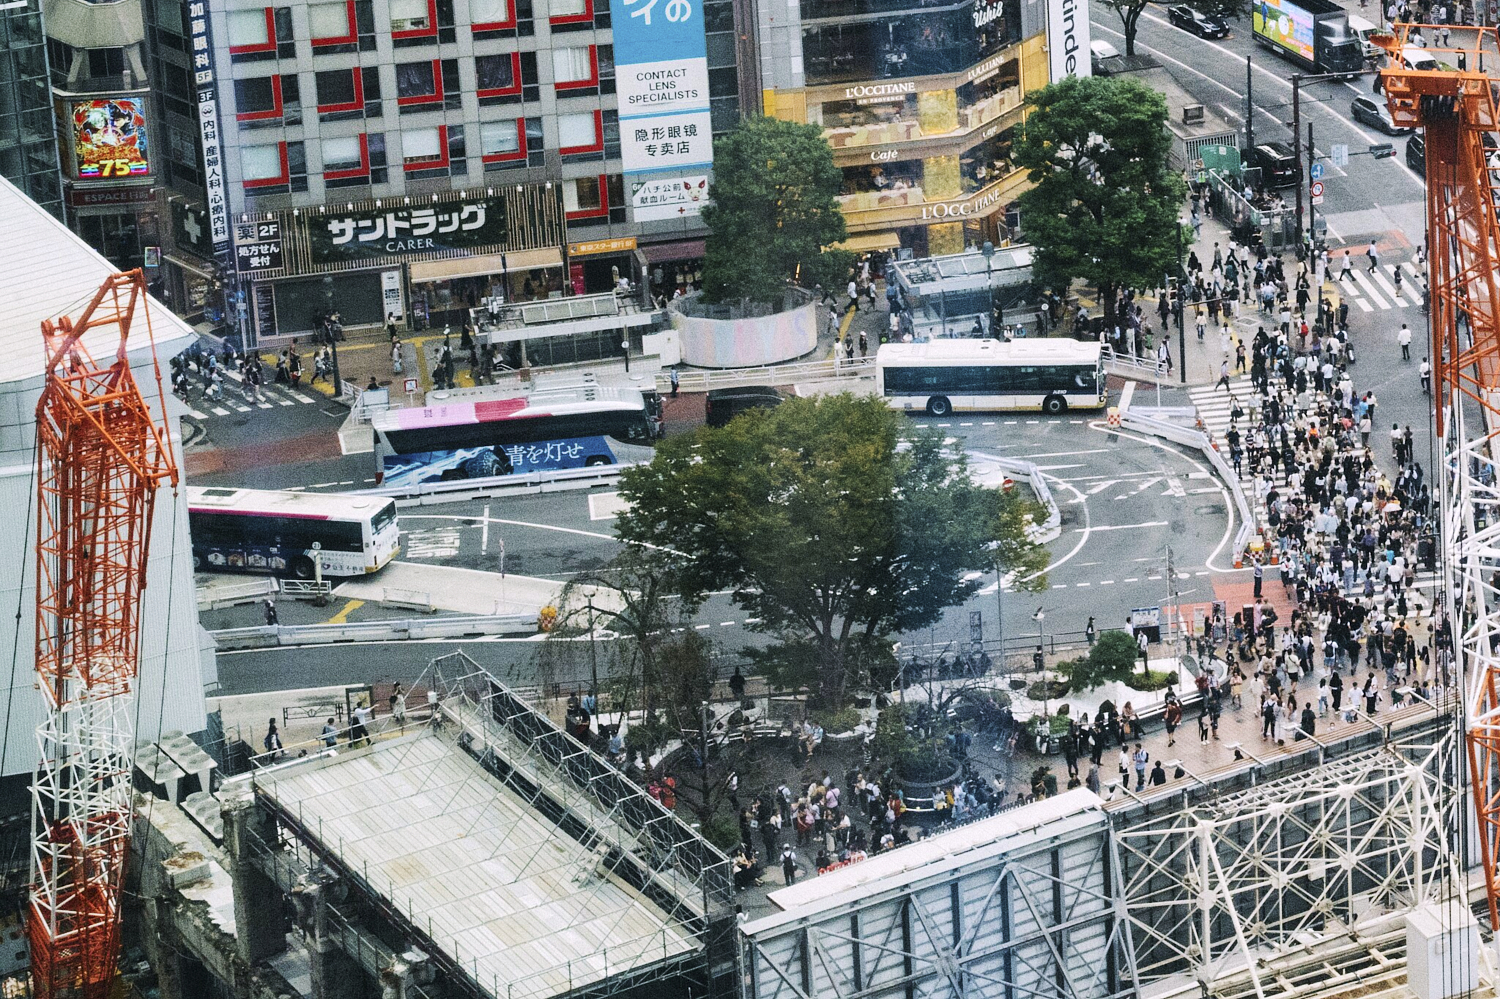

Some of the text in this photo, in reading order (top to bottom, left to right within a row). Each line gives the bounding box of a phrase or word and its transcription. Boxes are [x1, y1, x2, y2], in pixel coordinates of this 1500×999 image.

[190, 3, 210, 68] 加藤眼科
[636, 68, 687, 81] CONTACT
[649, 80, 676, 91] LENS
[199, 92, 213, 102] 3F
[628, 89, 698, 104] SPECIALISTS
[644, 140, 691, 157] 专卖店
[870, 149, 898, 161] Café
[259, 223, 277, 236] 2F
[327, 203, 487, 246] サンドラッグ
[238, 245, 279, 258] 処方せん
[386, 239, 434, 252] CARER
[506, 441, 584, 467] 青を灯せ
